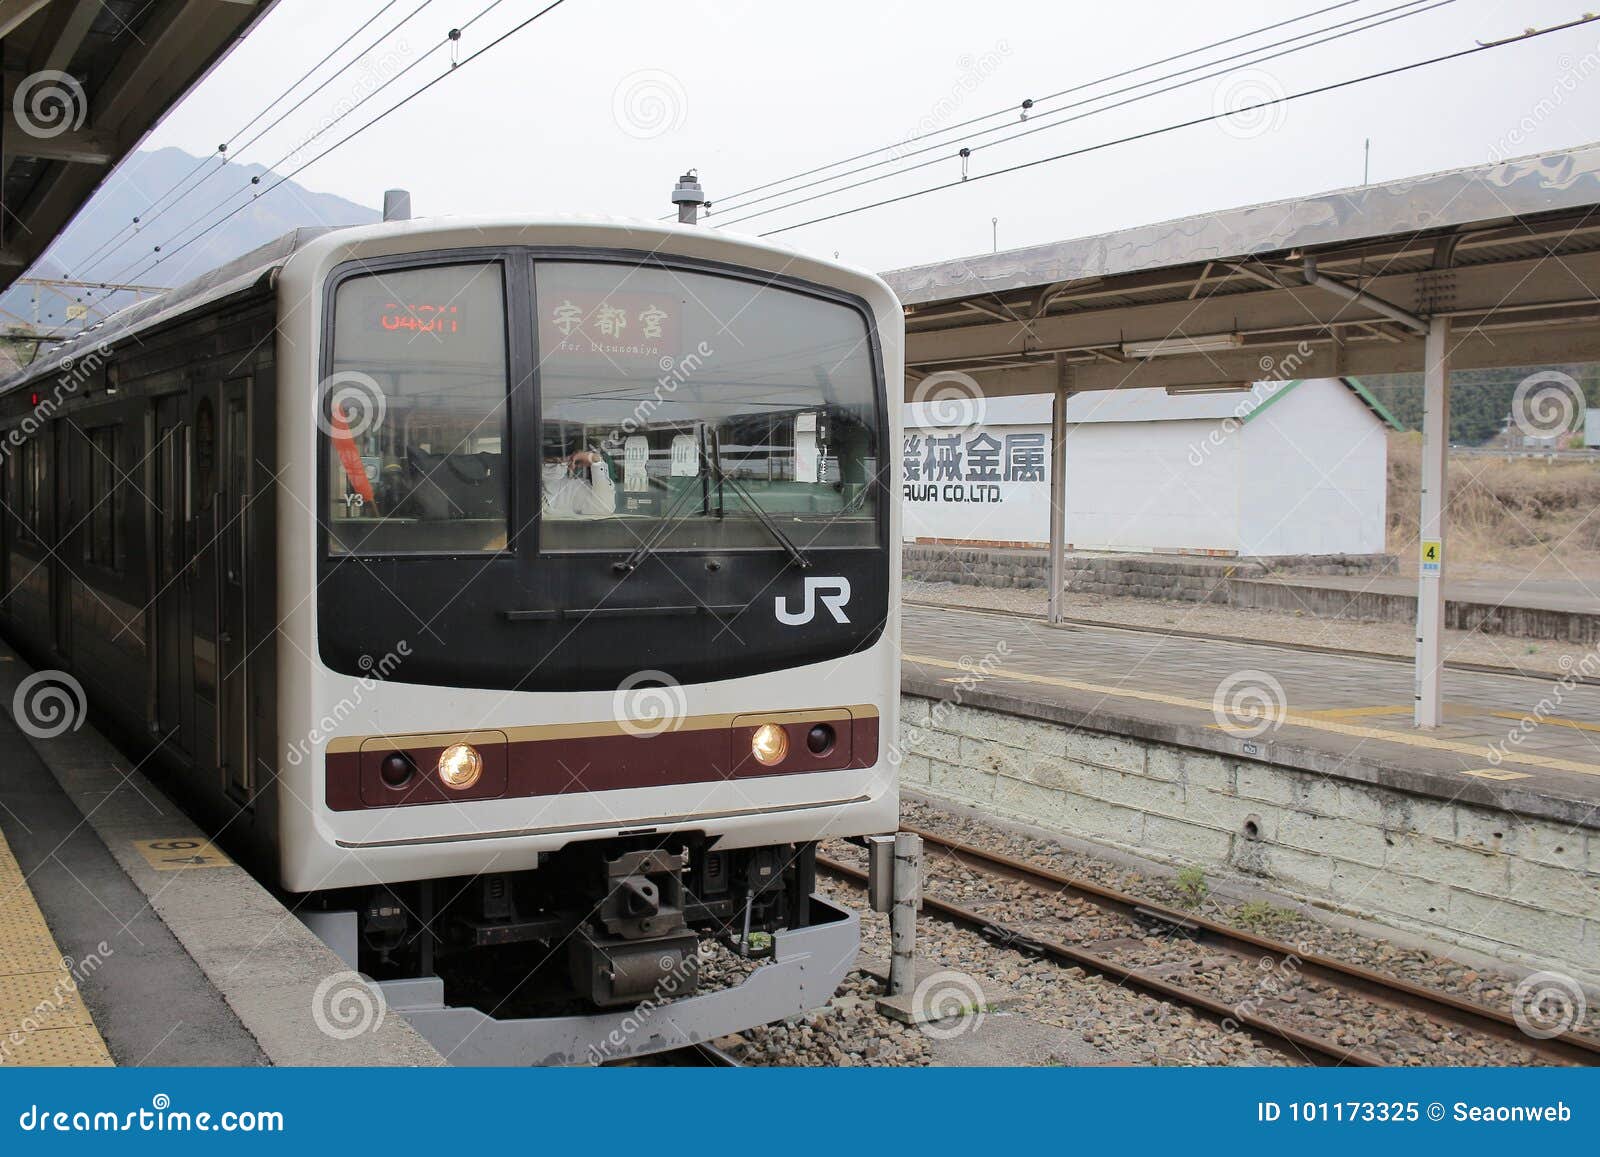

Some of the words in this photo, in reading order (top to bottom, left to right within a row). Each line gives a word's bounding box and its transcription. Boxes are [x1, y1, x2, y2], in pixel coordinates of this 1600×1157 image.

[552, 300, 668, 339] 宇都宮
[344, 493, 364, 507] Y3
[1426, 546, 1435, 560] 4
[775, 576, 851, 626] JR
